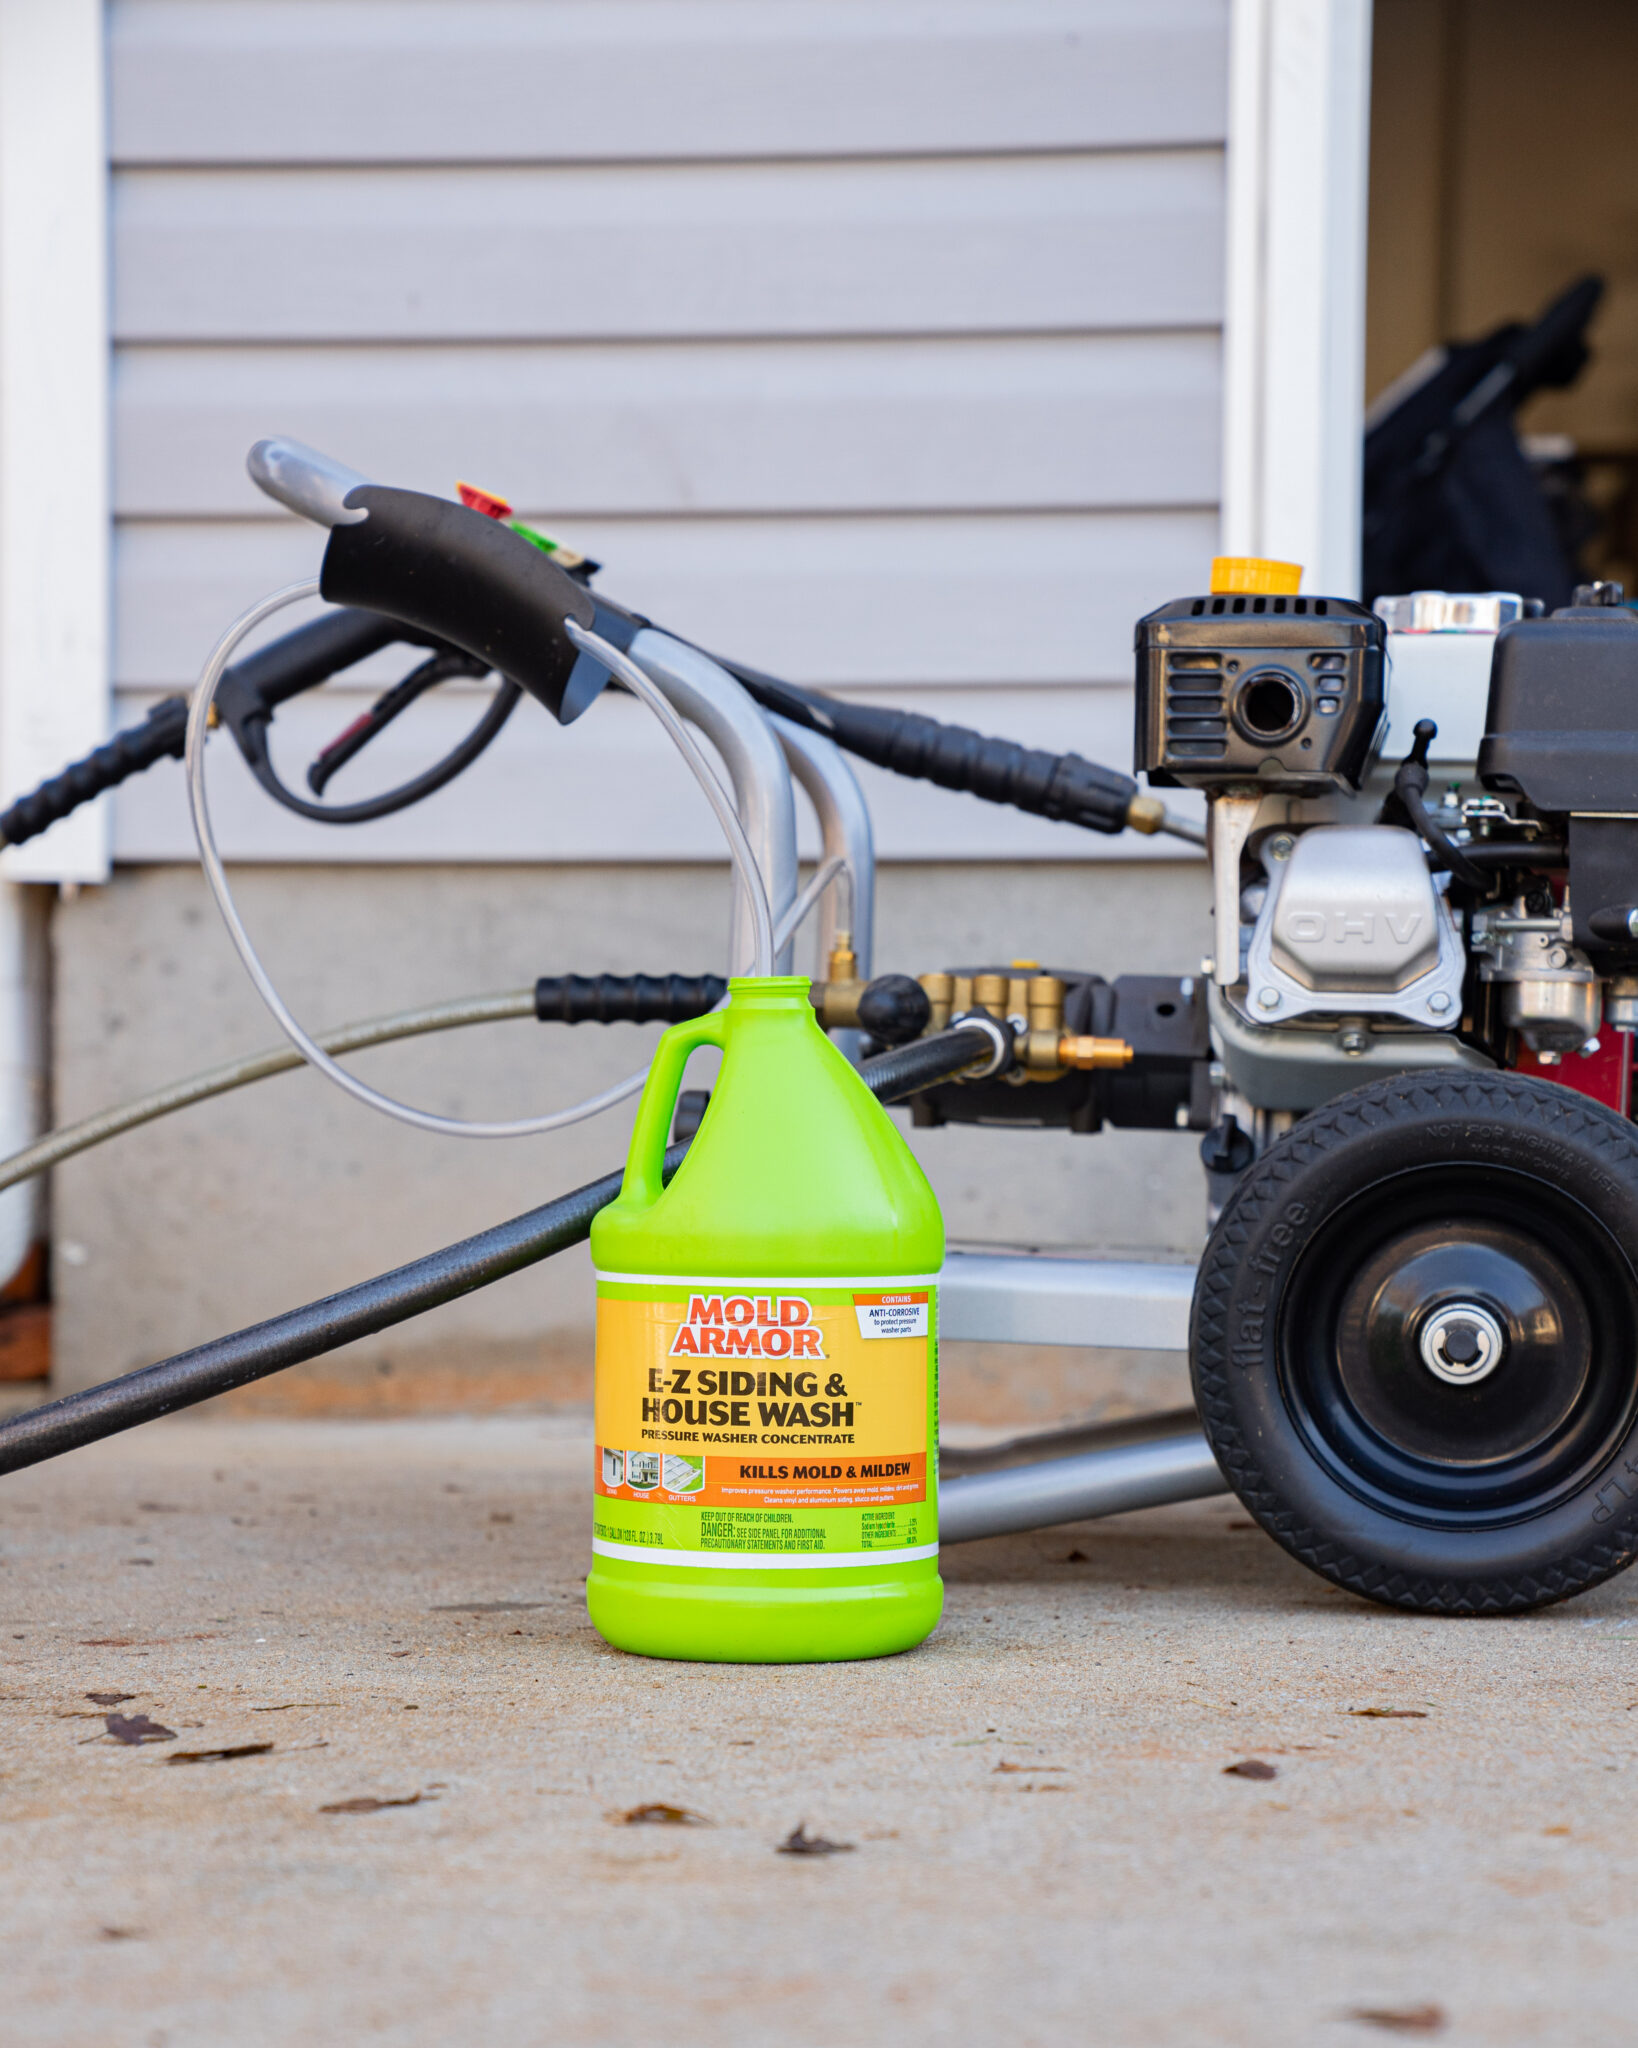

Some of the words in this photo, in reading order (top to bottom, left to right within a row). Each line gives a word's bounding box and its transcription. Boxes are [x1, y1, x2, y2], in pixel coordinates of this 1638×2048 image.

[1287, 911, 1422, 945] OHV
[1426, 1122, 1462, 1138] NOT
[1467, 1123, 1504, 1138] FOR
[1590, 1167, 1621, 1196] USE
[881, 1295, 912, 1304] CONTAINS
[688, 1296, 811, 1328] MOLD
[869, 1307, 920, 1318] ANTI-CORROSIVE
[880, 1318, 899, 1327] protect
[899, 1318, 917, 1326] pressure
[881, 1326, 900, 1334] washer
[900, 1326, 912, 1334] parts
[672, 1326, 822, 1357] ARMOR
[648, 1367, 692, 1395] E-Z
[697, 1369, 818, 1397] SIDING
[824, 1372, 848, 1397] &
[641, 1397, 751, 1427] HOUSE
[641, 1428, 700, 1443] PRESSURE
[702, 1431, 758, 1444] WASHER
[760, 1433, 855, 1445] CONCENTRATE
[739, 1464, 789, 1480] KILLS
[793, 1465, 843, 1480] MOLD
[846, 1465, 857, 1479] &
[860, 1461, 911, 1479] MILDEW
[668, 1494, 697, 1503] GUTTERS
[721, 1487, 748, 1495] Improves
[748, 1488, 774, 1496] pressure
[763, 1496, 783, 1504] Cleans
[784, 1496, 797, 1505] vinyl
[797, 1496, 809, 1504] and
[809, 1496, 837, 1504] aluminum
[701, 1511, 715, 1521] KEEP
[715, 1512, 727, 1521] OUT
[727, 1512, 736, 1522] OF
[736, 1512, 755, 1523] REACH
[755, 1513, 763, 1523] OF
[763, 1513, 794, 1524] CHILDREN.
[701, 1522, 736, 1538] DANGER:
[736, 1527, 748, 1539] SEE
[748, 1528, 761, 1539] SIDE
[762, 1528, 780, 1539] PANEL
[781, 1528, 793, 1539] FOR
[794, 1528, 827, 1539] ADDITIONAL
[700, 1537, 746, 1550] PRECAUTIONARY
[746, 1539, 783, 1551] STATEMENTS
[784, 1539, 796, 1551] AND
[797, 1539, 813, 1551] FIRST
[813, 1539, 825, 1551] AID.
